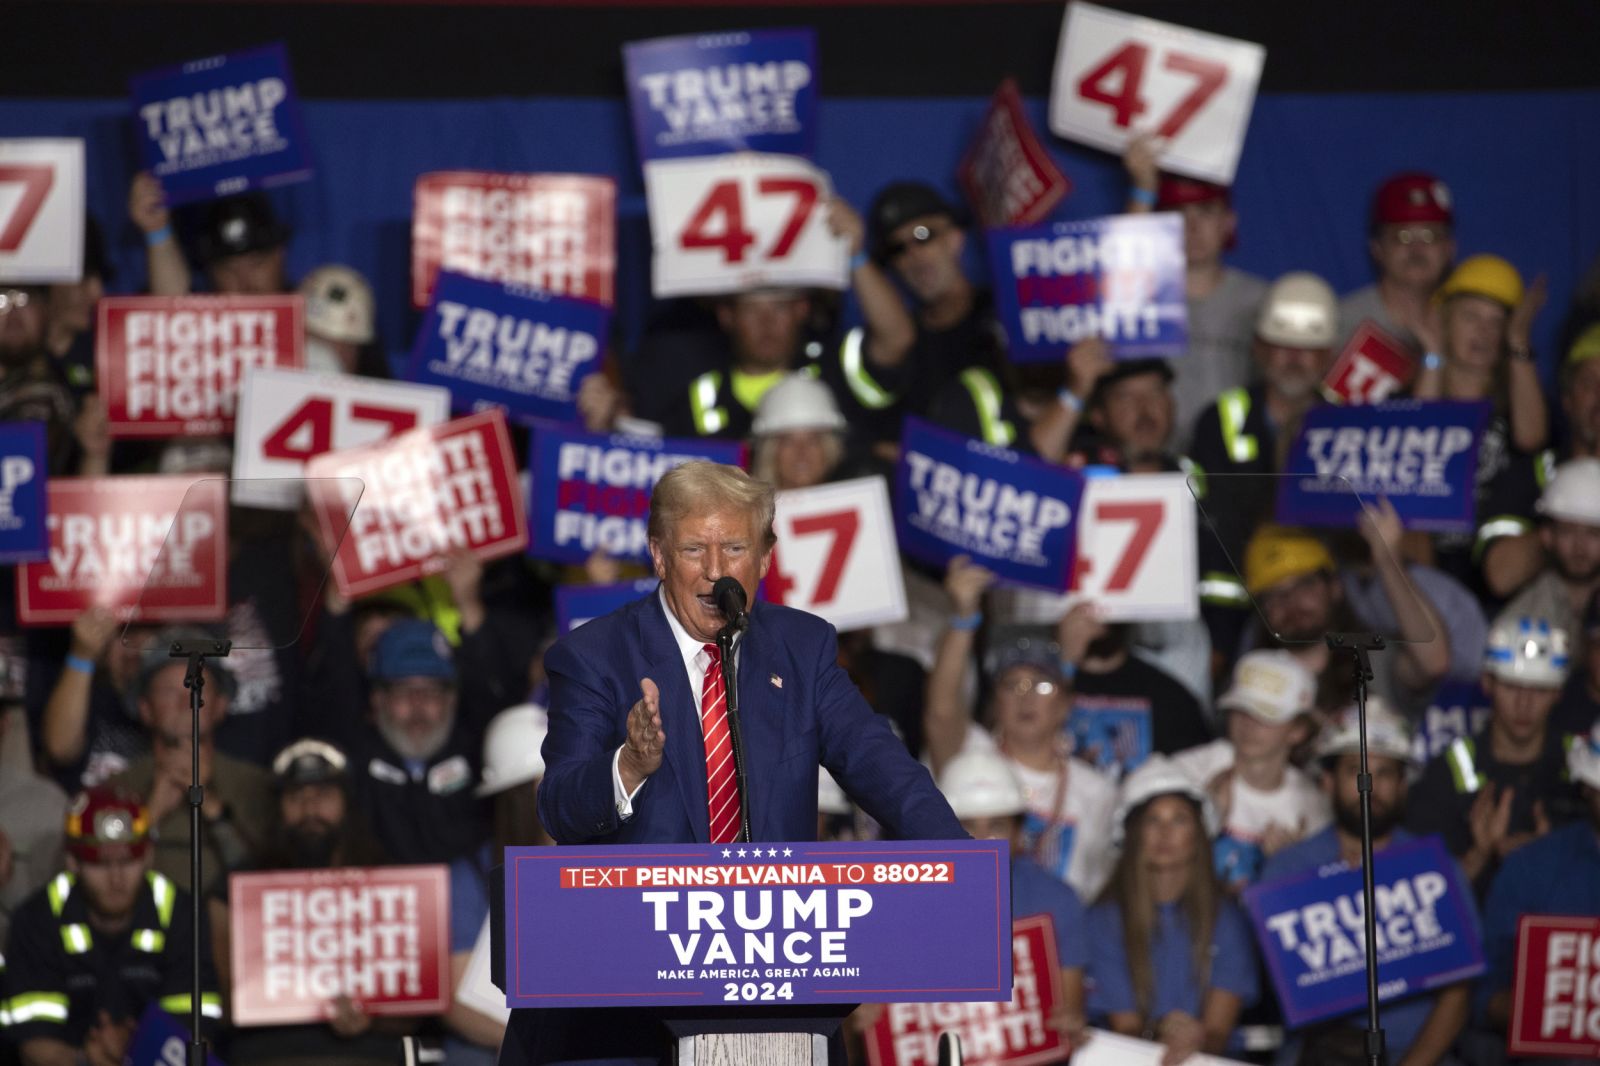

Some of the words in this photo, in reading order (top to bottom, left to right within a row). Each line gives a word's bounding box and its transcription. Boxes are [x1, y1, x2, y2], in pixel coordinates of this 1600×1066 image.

[140, 77, 286, 140] TRUMP
[640, 60, 812, 112] TRUMP
[1075, 42, 1229, 139] 47
[158, 107, 279, 161] VANCE
[664, 92, 796, 131] VANCE
[677, 179, 818, 265] 47
[126, 310, 277, 346] FIGHT!
[437, 301, 599, 371] TRUMP
[1020, 300, 1161, 345] FIGHT!
[446, 339, 576, 390] VANCE
[127, 381, 241, 420] FIGH
[261, 394, 420, 462] 47
[1305, 425, 1473, 462] TRUMP
[337, 428, 485, 504] FIGHT!
[558, 442, 712, 489] FIGH
[1314, 452, 1447, 486] VANCE
[345, 464, 495, 540] FIGHT!
[906, 450, 1071, 530] TRUMP
[353, 499, 506, 575] FIGHT!
[918, 489, 1047, 556] VANCE
[49, 544, 193, 578] VANCE
[566, 867, 629, 888] TEXT
[636, 864, 827, 886] PENNSYLVANIA
[832, 864, 866, 884] TO
[873, 863, 950, 884] 88022
[261, 884, 418, 927] FIGHT!
[642, 889, 874, 931] TRUMP
[1265, 871, 1448, 950] TRUMP
[263, 922, 420, 964] FIGHT!
[668, 931, 848, 965] VANCE
[265, 959, 421, 1001] FIGHT!
[657, 969, 696, 980] MAKE
[700, 968, 760, 979] AMERICA
[765, 967, 808, 978] GREAT
[813, 966, 861, 978] AGAIN!
[724, 982, 795, 1001] 2024
[895, 1012, 1046, 1066] FIHT!
